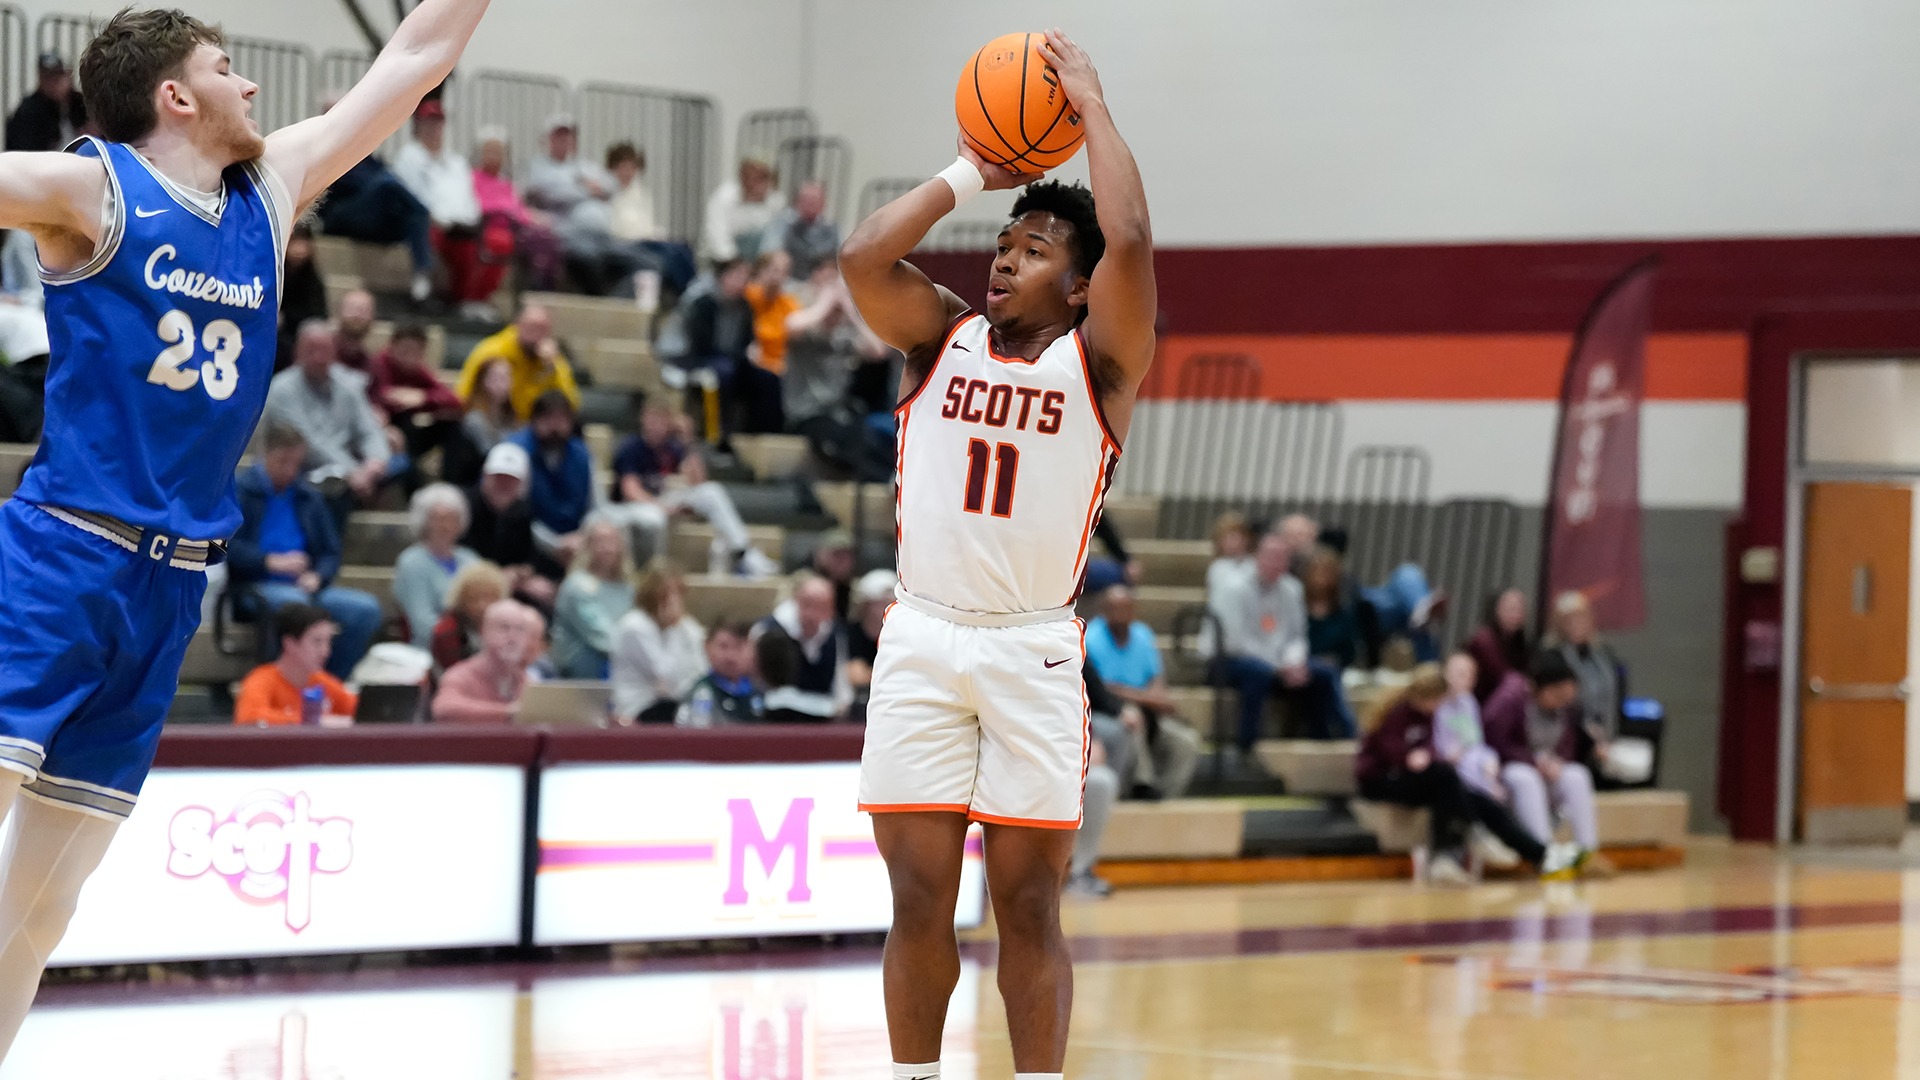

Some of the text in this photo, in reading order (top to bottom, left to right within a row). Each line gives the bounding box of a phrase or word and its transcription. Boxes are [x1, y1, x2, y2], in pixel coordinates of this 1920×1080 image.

[144, 243, 264, 310] Covenant
[146, 309, 244, 401] 23
[941, 375, 1066, 436] SCOTS
[963, 436, 1020, 519] 11
[149, 534, 169, 561] C
[722, 797, 815, 906] M
